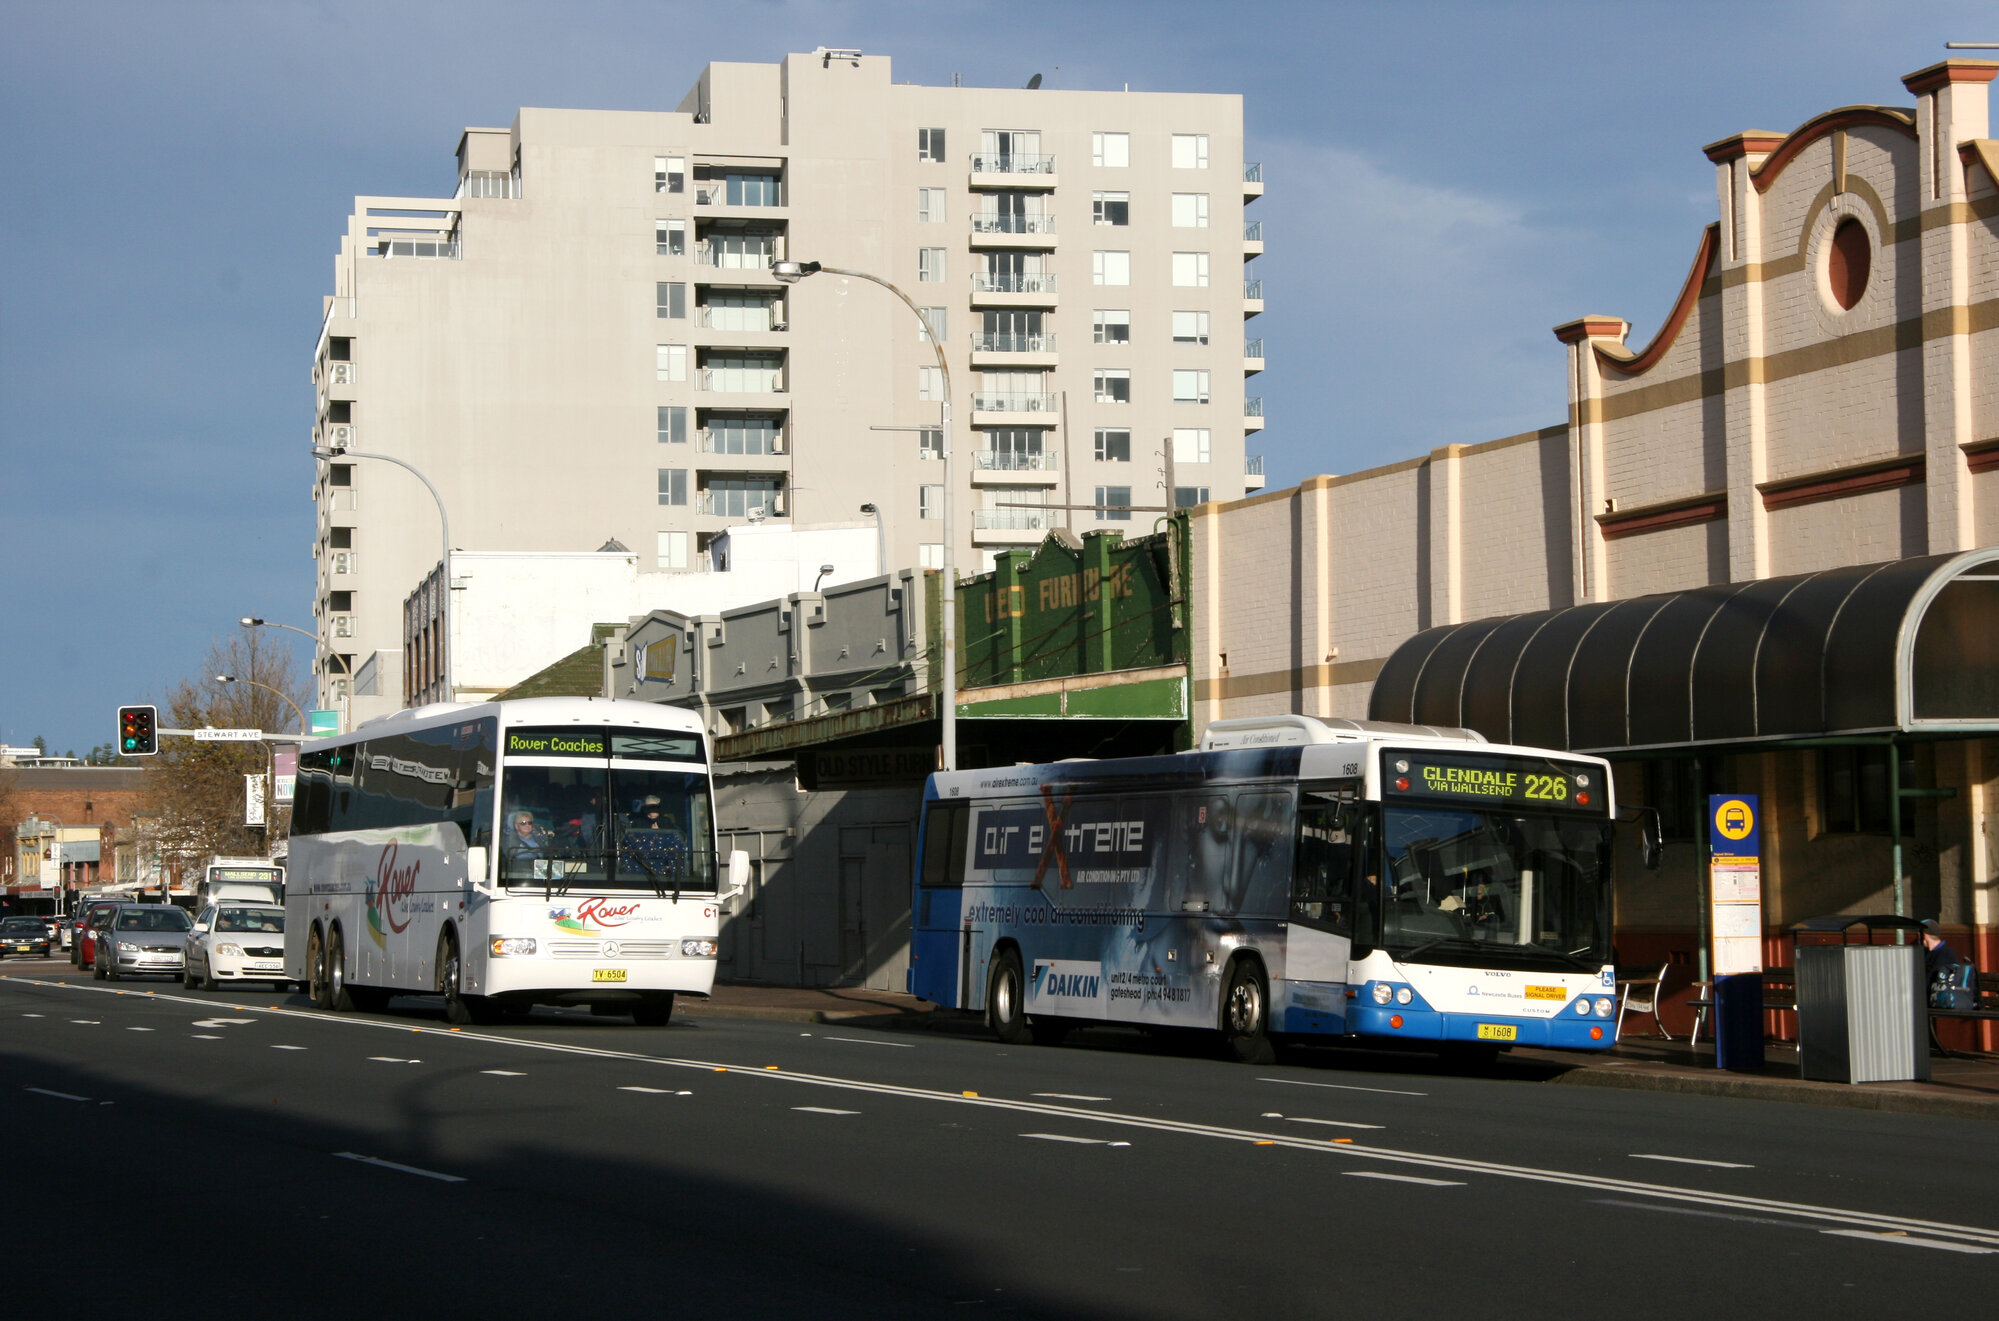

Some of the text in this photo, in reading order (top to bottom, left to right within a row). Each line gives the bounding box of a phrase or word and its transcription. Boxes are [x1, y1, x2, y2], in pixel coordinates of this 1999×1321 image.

[510, 735, 604, 753] Rover Coaches
[818, 757, 844, 777] OLD
[848, 754, 890, 777] STYLE
[1342, 763, 1358, 775] 1608
[1424, 766, 1517, 787] GLENDALE
[1427, 780, 1513, 797] VIA WALLSEND
[1524, 774, 1568, 800] 226
[258, 872, 272, 880] 231
[1076, 870, 1086, 883] AIR
[1120, 870, 1131, 883] PTY
[1130, 870, 1140, 883] LTD
[577, 897, 641, 930] Rover
[704, 907, 717, 918] C1
[969, 901, 1146, 932] extremely cool air conditioning
[595, 970, 626, 978] TV 6504
[1047, 973, 1100, 998] DAIKIN
[1111, 986, 1142, 1001] gateshead
[1525, 991, 1566, 1000] SIGNAL DRIVER
[1493, 1027, 1512, 1038] 1608
